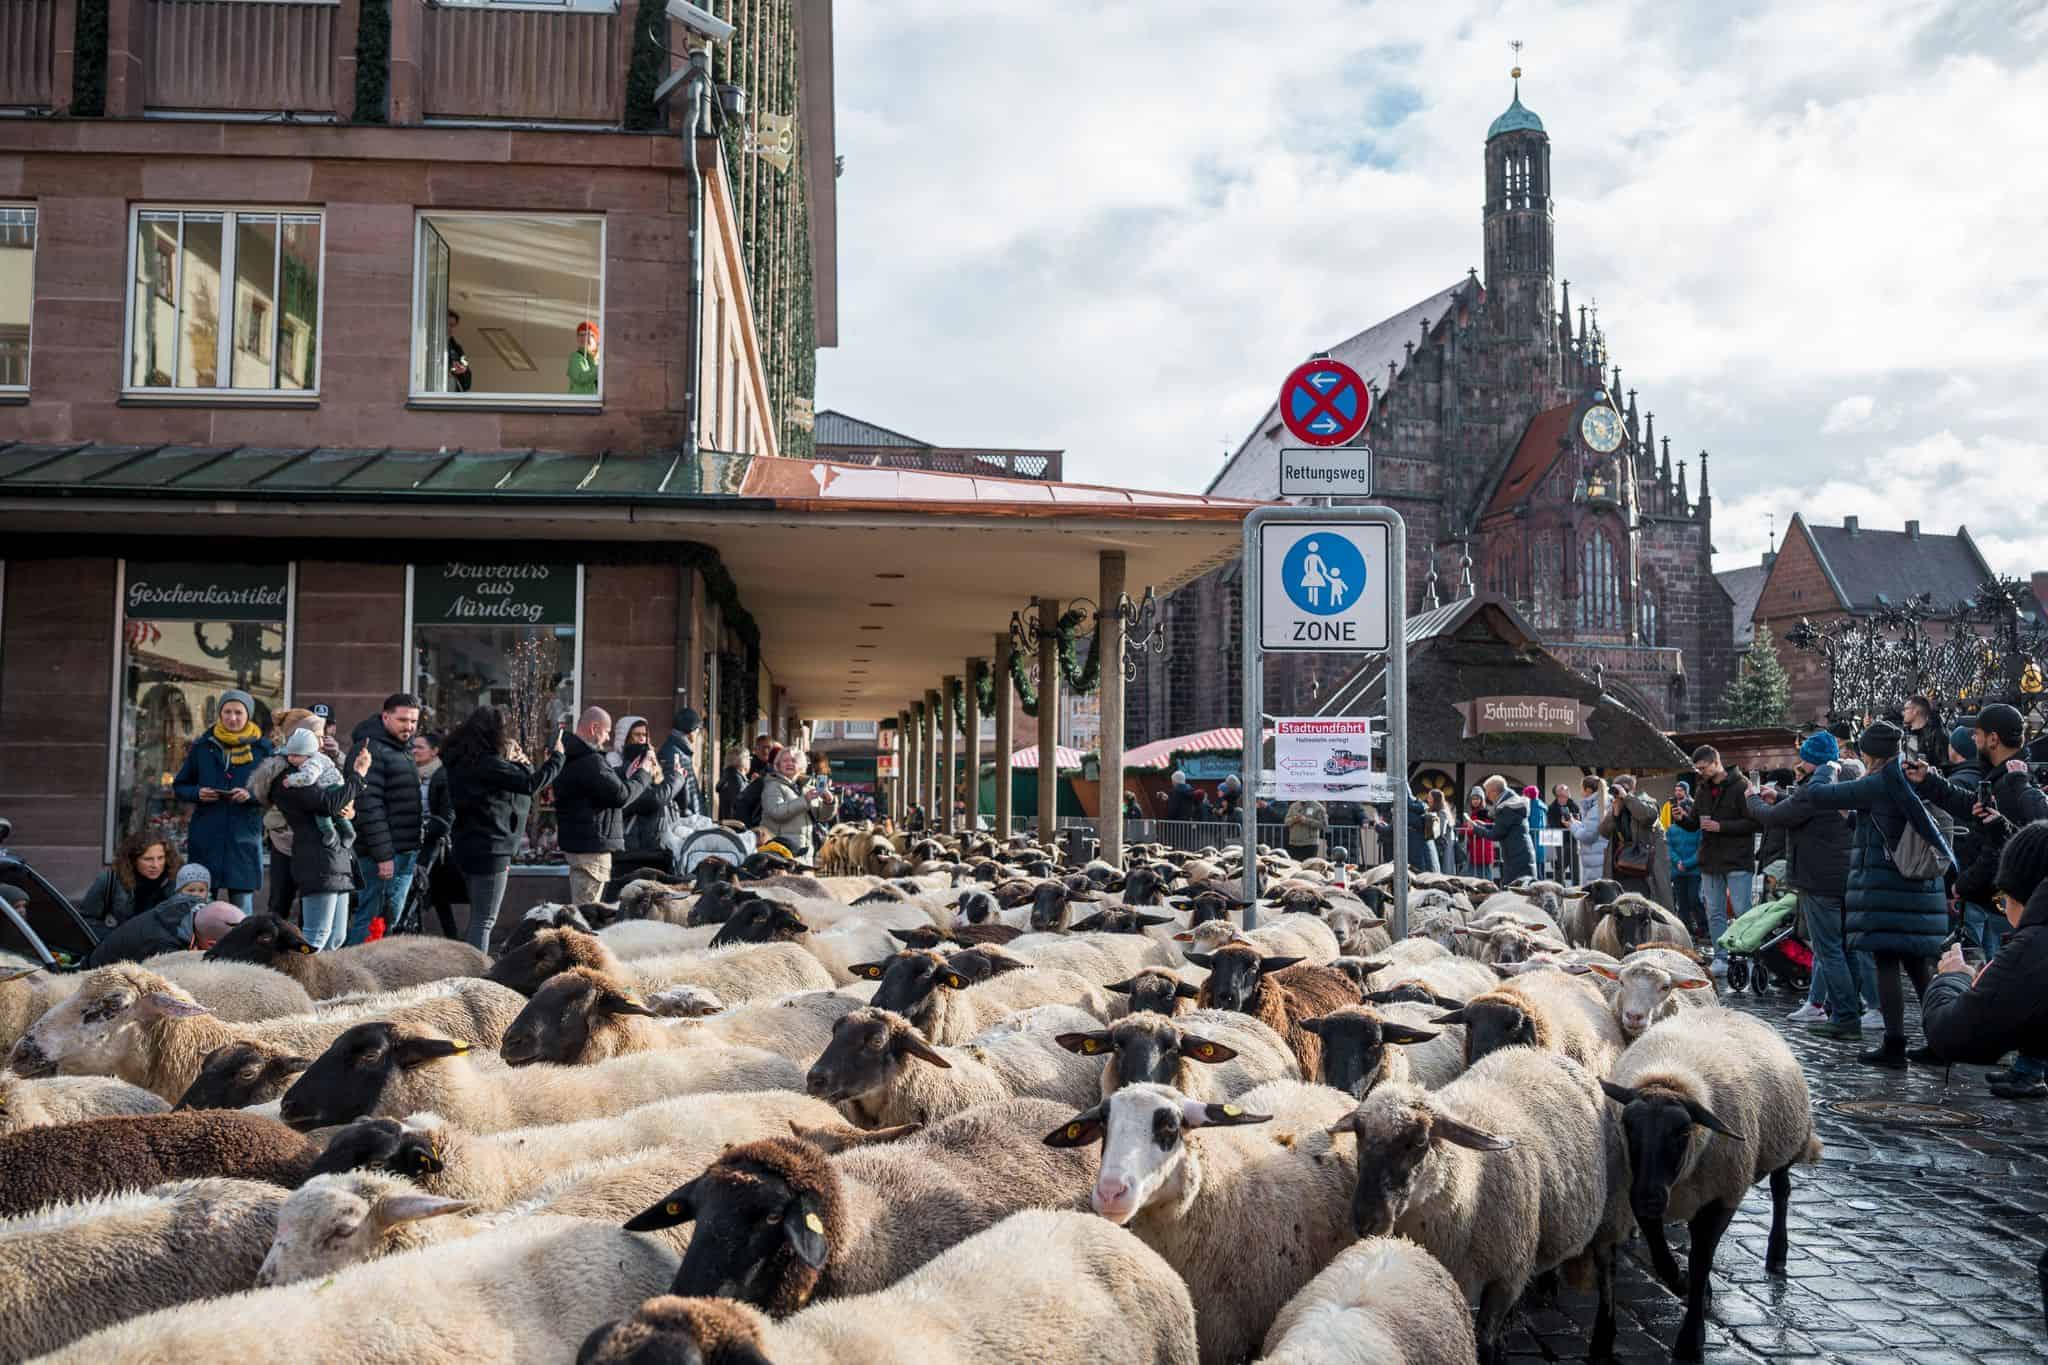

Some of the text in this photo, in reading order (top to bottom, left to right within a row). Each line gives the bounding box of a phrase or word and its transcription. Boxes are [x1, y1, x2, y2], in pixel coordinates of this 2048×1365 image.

[1286, 465, 1365, 483] Rettungsweg
[443, 562, 549, 579] Souvenirs
[129, 582, 286, 607] Geschenkartikel
[476, 581, 515, 595] aus
[445, 595, 544, 622] Nürnberg
[1293, 621, 1356, 641] ZONE
[1281, 723, 1362, 734] Stadtrundfahrt
